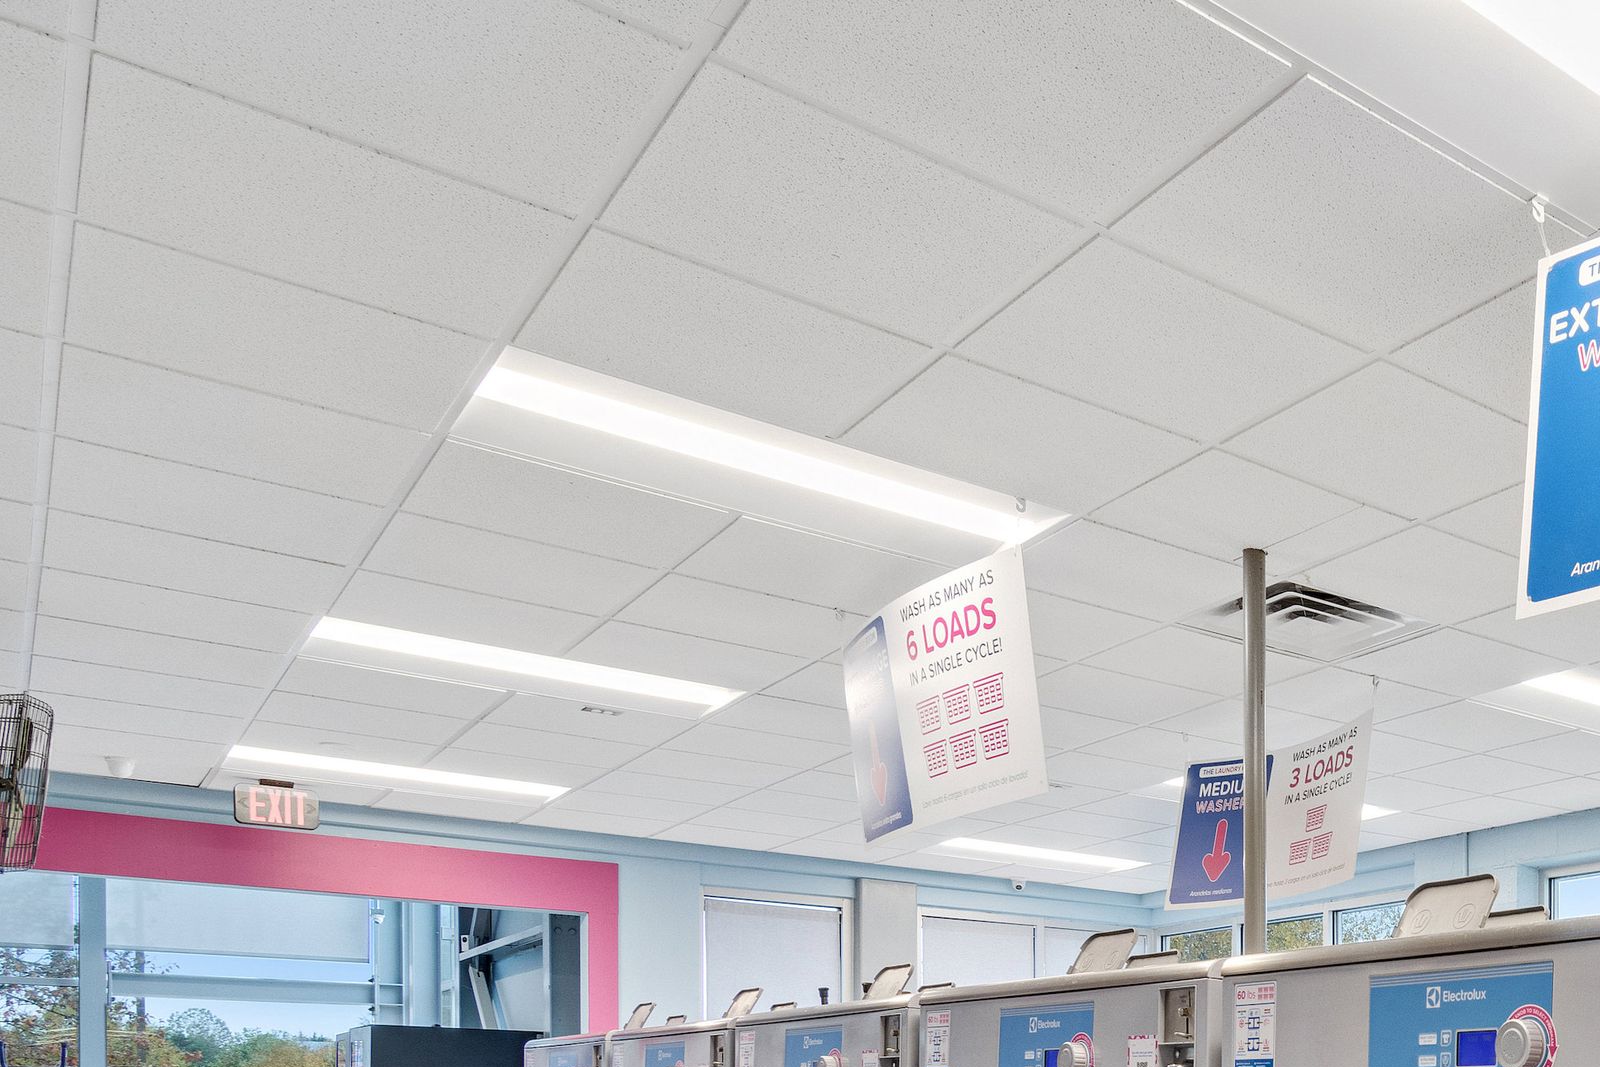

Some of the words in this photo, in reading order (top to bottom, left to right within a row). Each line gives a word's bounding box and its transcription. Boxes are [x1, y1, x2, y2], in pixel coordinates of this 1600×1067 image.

[900, 598, 925, 622] WASH
[929, 592, 941, 610] AS
[944, 576, 974, 602] MANY
[979, 569, 994, 588] AS
[907, 630, 918, 660] 6
[922, 597, 997, 653] LOADS
[910, 672, 919, 686] IN
[921, 667, 927, 681] A
[929, 651, 962, 677] SINGLE
[965, 637, 1003, 663] CYCLE!
[1293, 748, 1315, 762] WASH
[1317, 742, 1326, 754] AS
[1328, 734, 1348, 750] MANY
[1349, 727, 1357, 742] AS
[1215, 765, 1241, 774] LAUNDRY
[1289, 768, 1301, 788] 3
[1305, 745, 1354, 784] LOADS
[1199, 779, 1243, 797] MEDIU
[1285, 795, 1294, 805] IN
[1294, 793, 1300, 802] A
[1301, 785, 1328, 801] SINGLE
[1329, 772, 1352, 791] CYCLE!
[249, 787, 308, 825] EXIT
[1237, 991, 1246, 1000] 60
[1443, 989, 1486, 1003] Electrolux
[1038, 1019, 1061, 1029] Electrolux
[1533, 1009, 1547, 1021] SELECT
